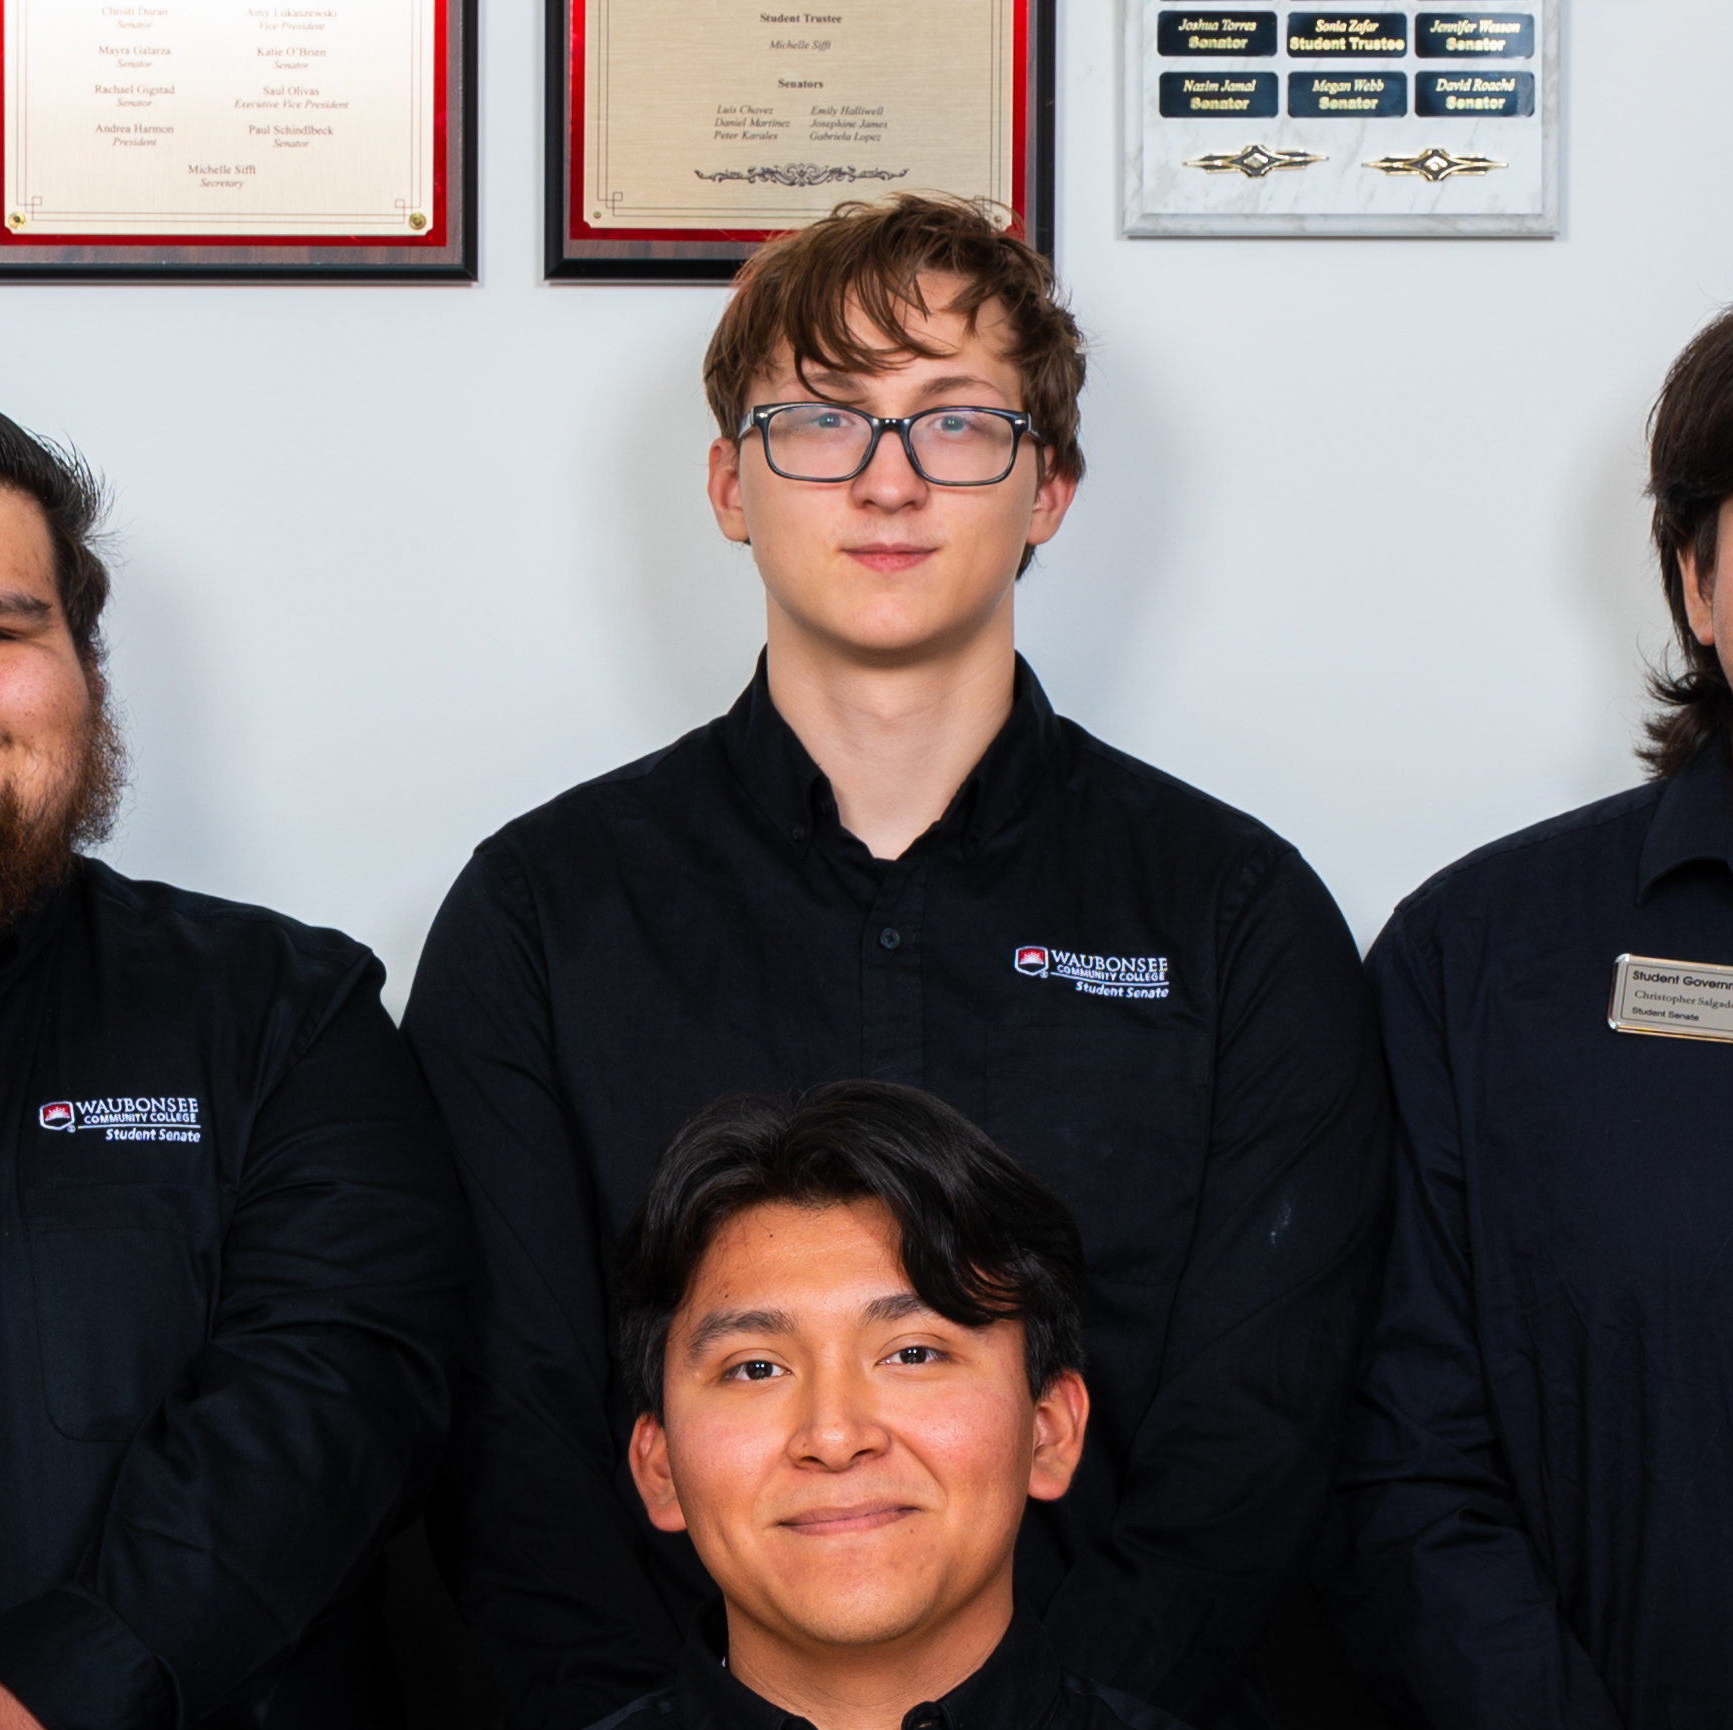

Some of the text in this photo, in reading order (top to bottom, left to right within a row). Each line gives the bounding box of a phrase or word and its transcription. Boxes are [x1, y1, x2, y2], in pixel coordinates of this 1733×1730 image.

[1051, 950, 1168, 972] WAUBONSEE
[1057, 964, 1165, 981] COMMUNITY COLLEGE
[1633, 970, 1679, 985] Student
[1076, 981, 1169, 998] Student Senate
[1634, 990, 1696, 1005] Christopher
[1632, 1007, 1699, 1021] Student Senate
[76, 1098, 198, 1114] WAUBONSEE
[84, 1112, 196, 1124] COMMUNITY COLLEGE
[106, 1129, 201, 1142] Student Senate
